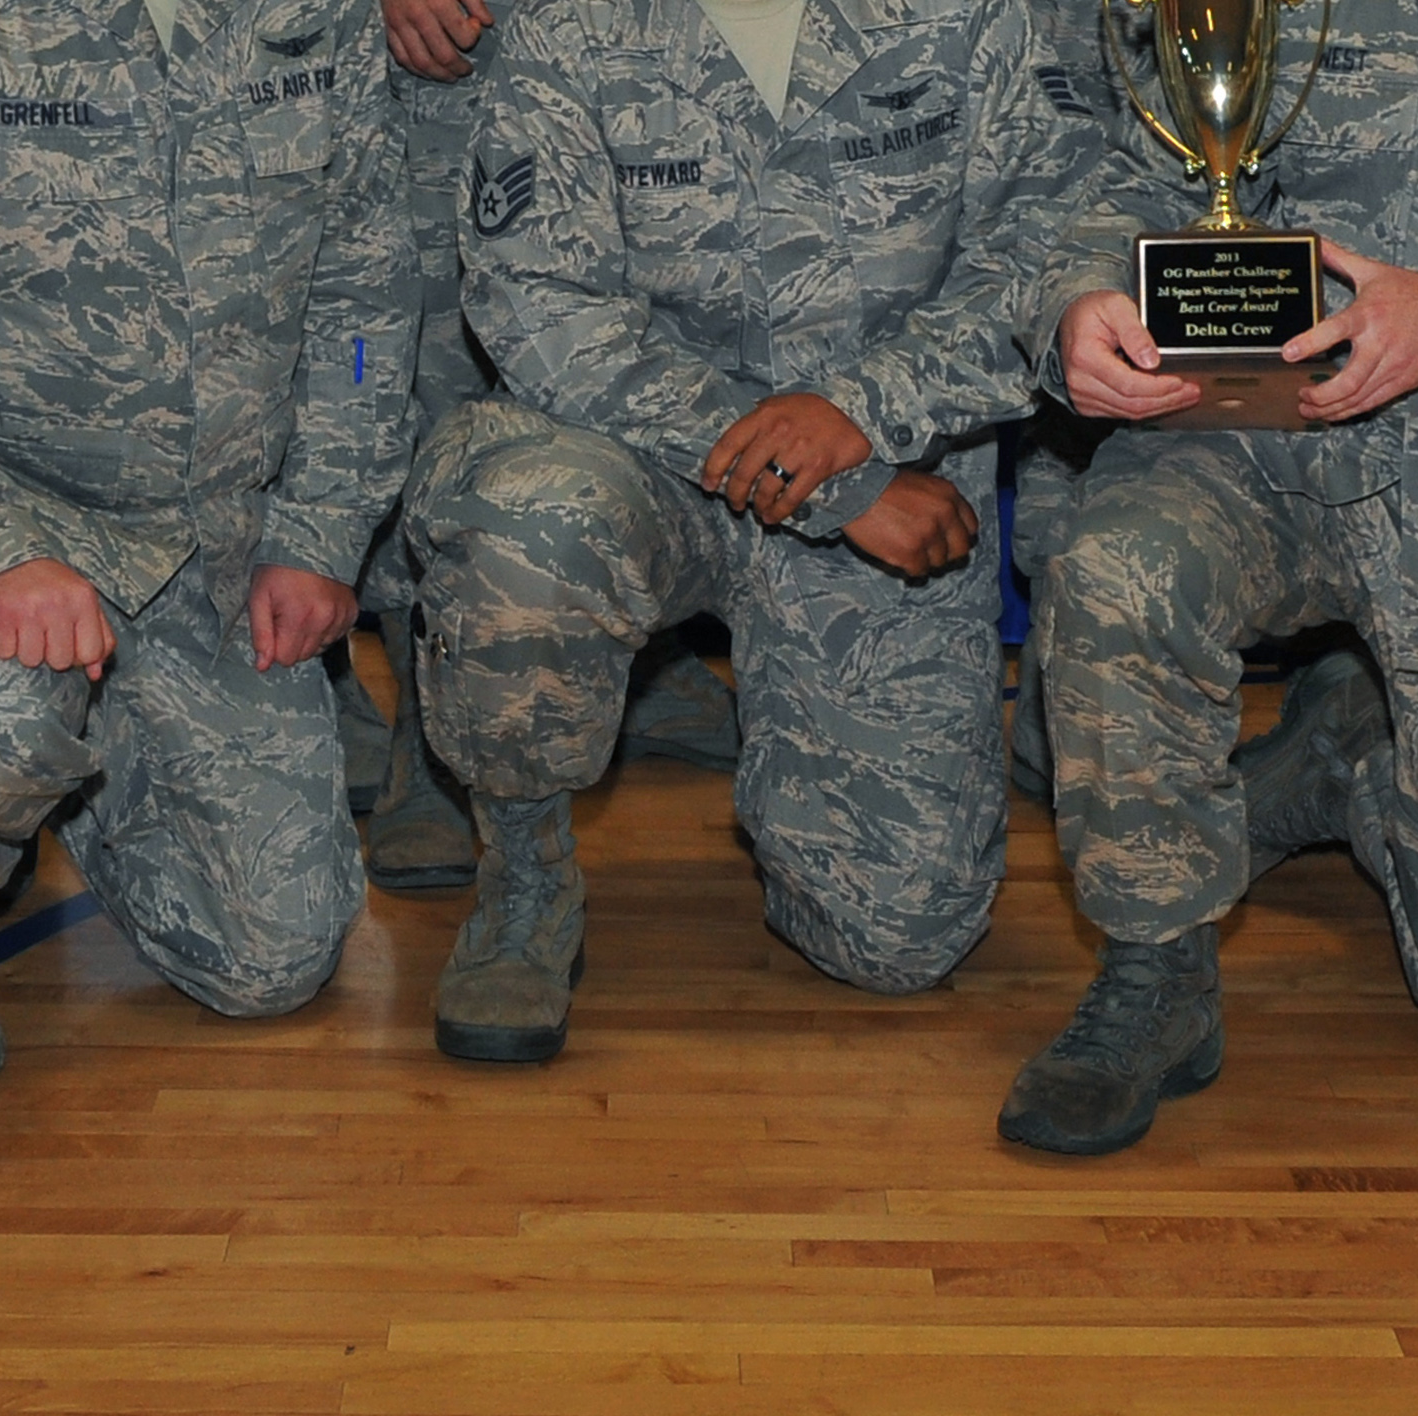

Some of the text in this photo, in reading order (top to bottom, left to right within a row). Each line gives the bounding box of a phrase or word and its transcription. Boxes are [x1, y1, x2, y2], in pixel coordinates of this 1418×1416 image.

[248, 81, 279, 105] U.S.
[283, 73, 313, 99] AIR
[1, 102, 94, 126] GRENFELL
[844, 108, 961, 162] U.S. AIR FORCE
[1163, 266, 1292, 280] OG Panther Challenge
[1171, 286, 1201, 299] Space
[1202, 285, 1247, 298] Warning
[1248, 285, 1300, 298] Squadron
[1179, 300, 1279, 313] Best Crew Award
[1185, 322, 1273, 336] Delta Crew
